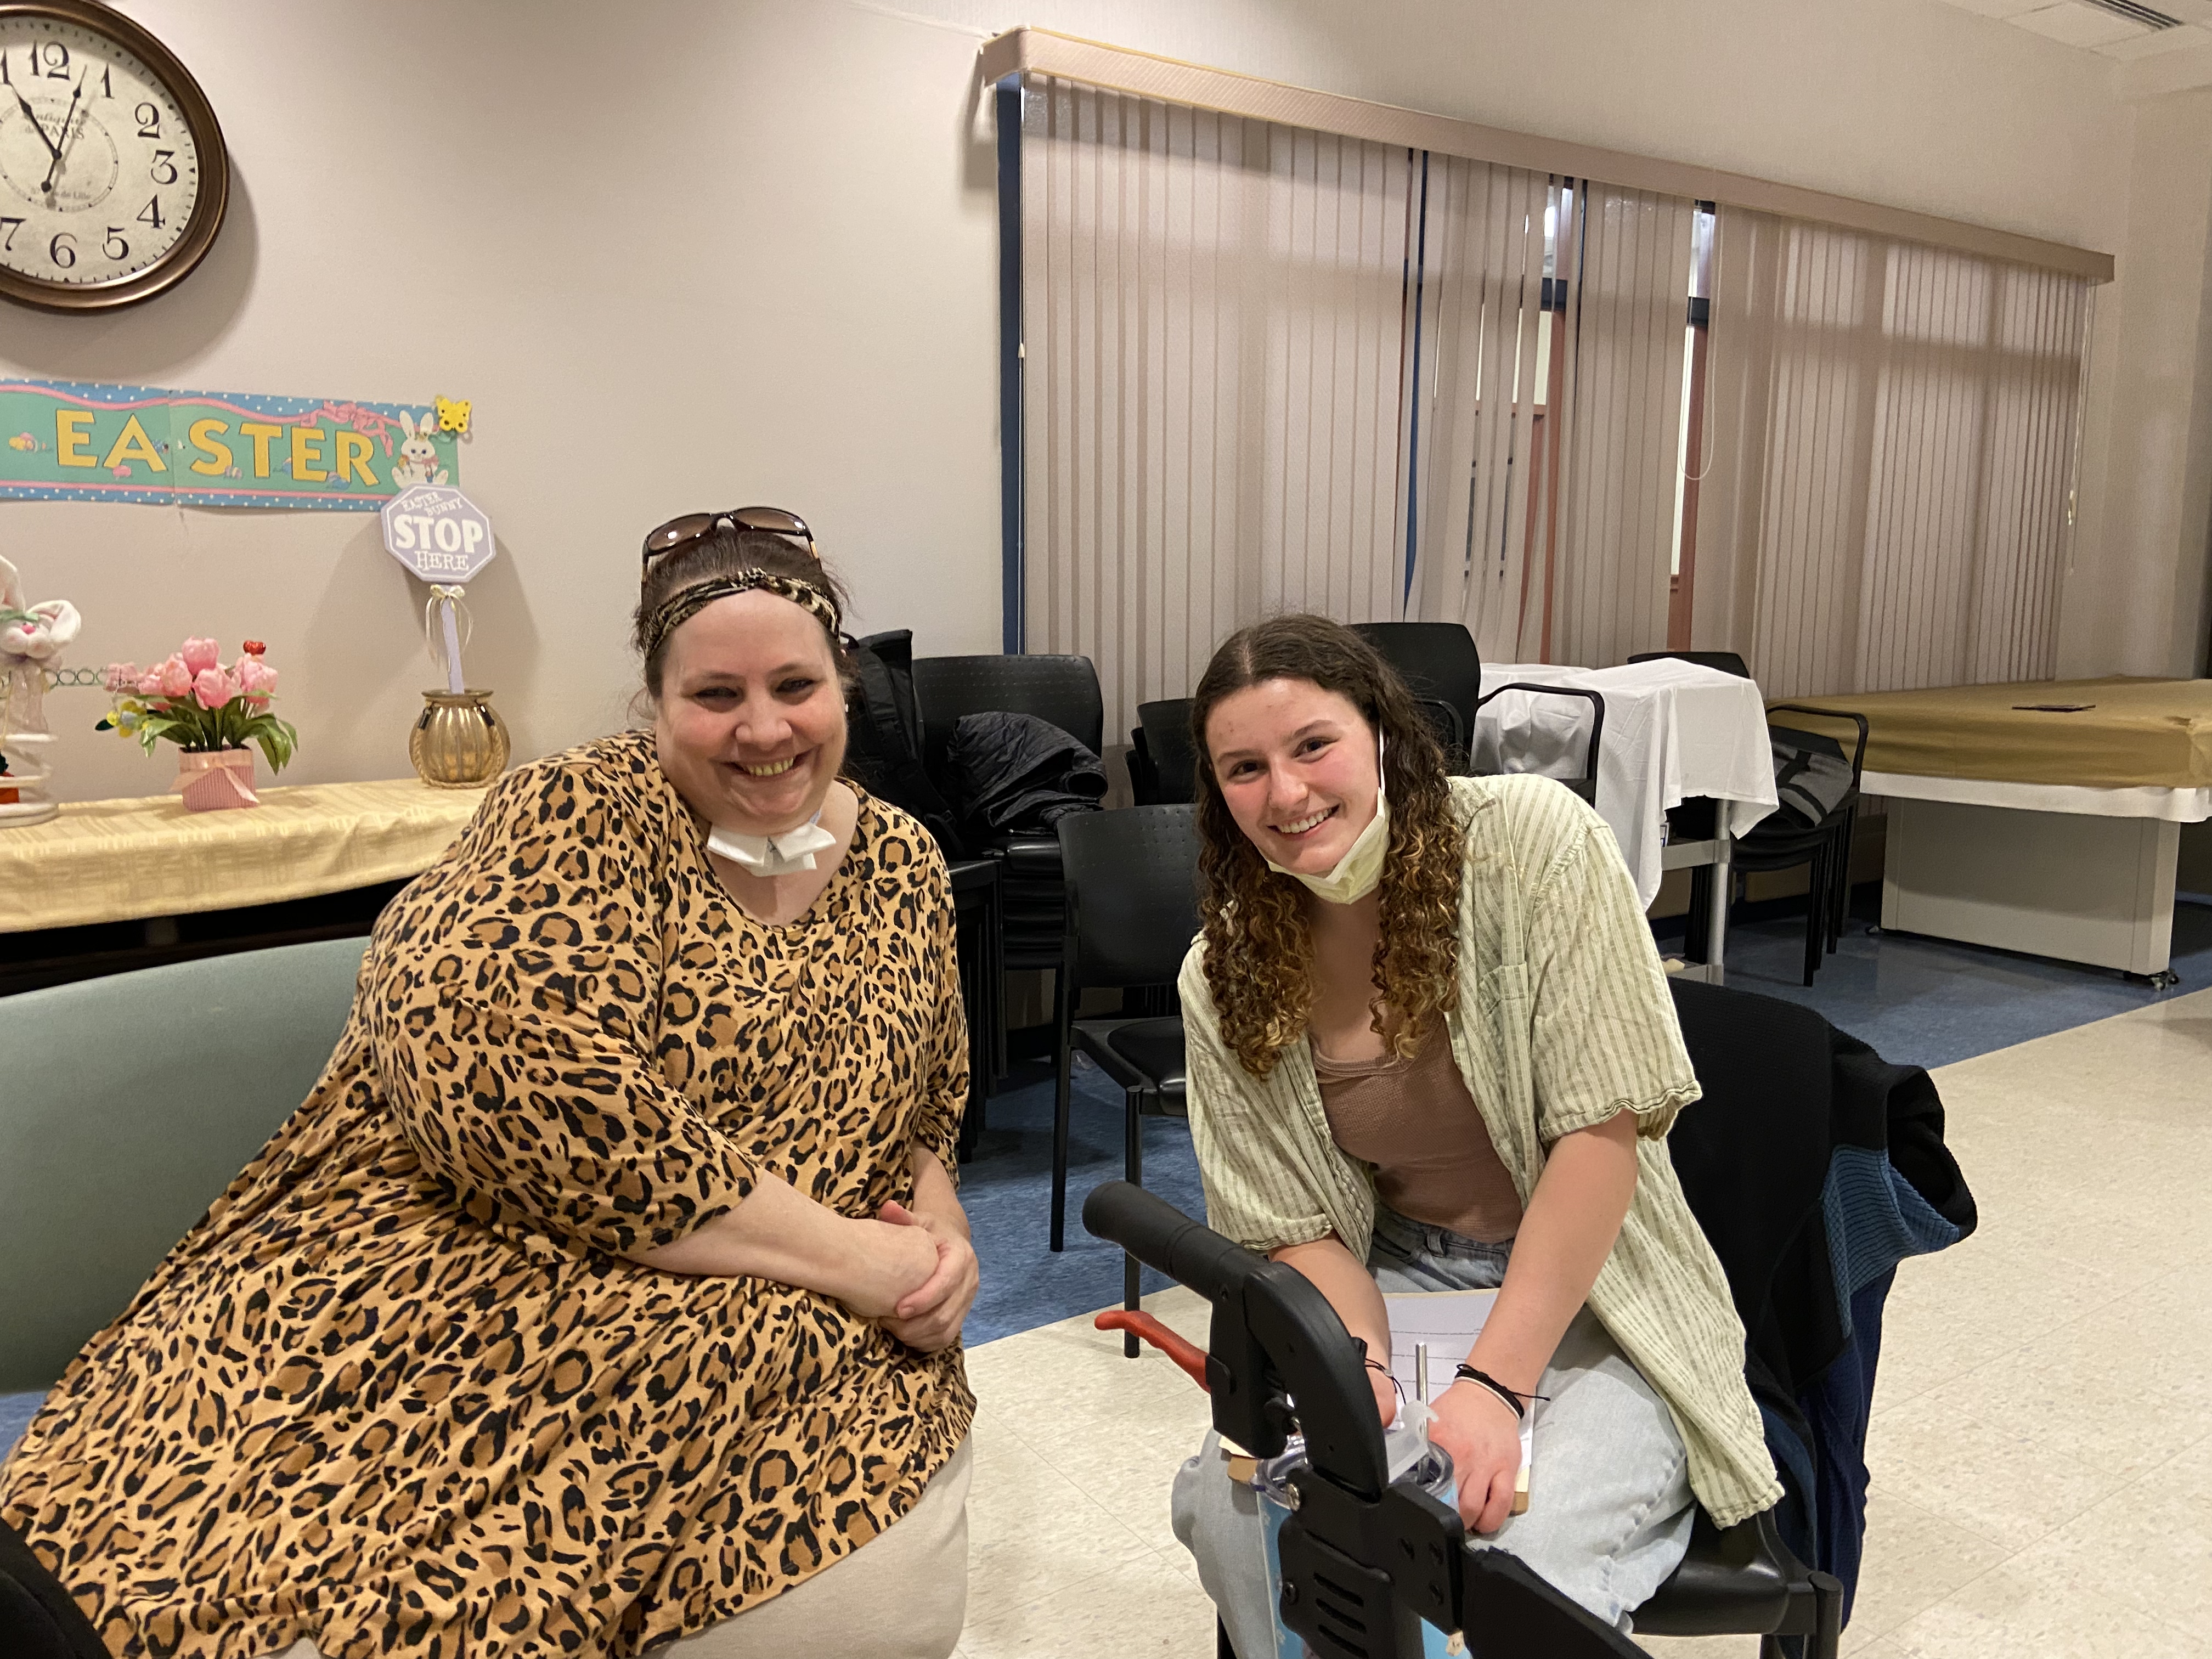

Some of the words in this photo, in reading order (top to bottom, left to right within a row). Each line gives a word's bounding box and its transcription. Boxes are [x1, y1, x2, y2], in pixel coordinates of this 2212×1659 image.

[29, 40, 70, 81] 12
[101, 64, 115, 99] 1
[135, 102, 160, 139] 2
[150, 150, 178, 184] 3
[136, 194, 165, 229] 4
[0, 217, 26, 251] 7
[50, 232, 77, 268] 6
[103, 227, 129, 260] 5
[56, 409, 380, 486] EASTER
[401, 492, 442, 512] EASTER
[424, 497, 463, 516] BUNNY
[394, 514, 483, 553] STOP
[414, 550, 469, 571] HERE
